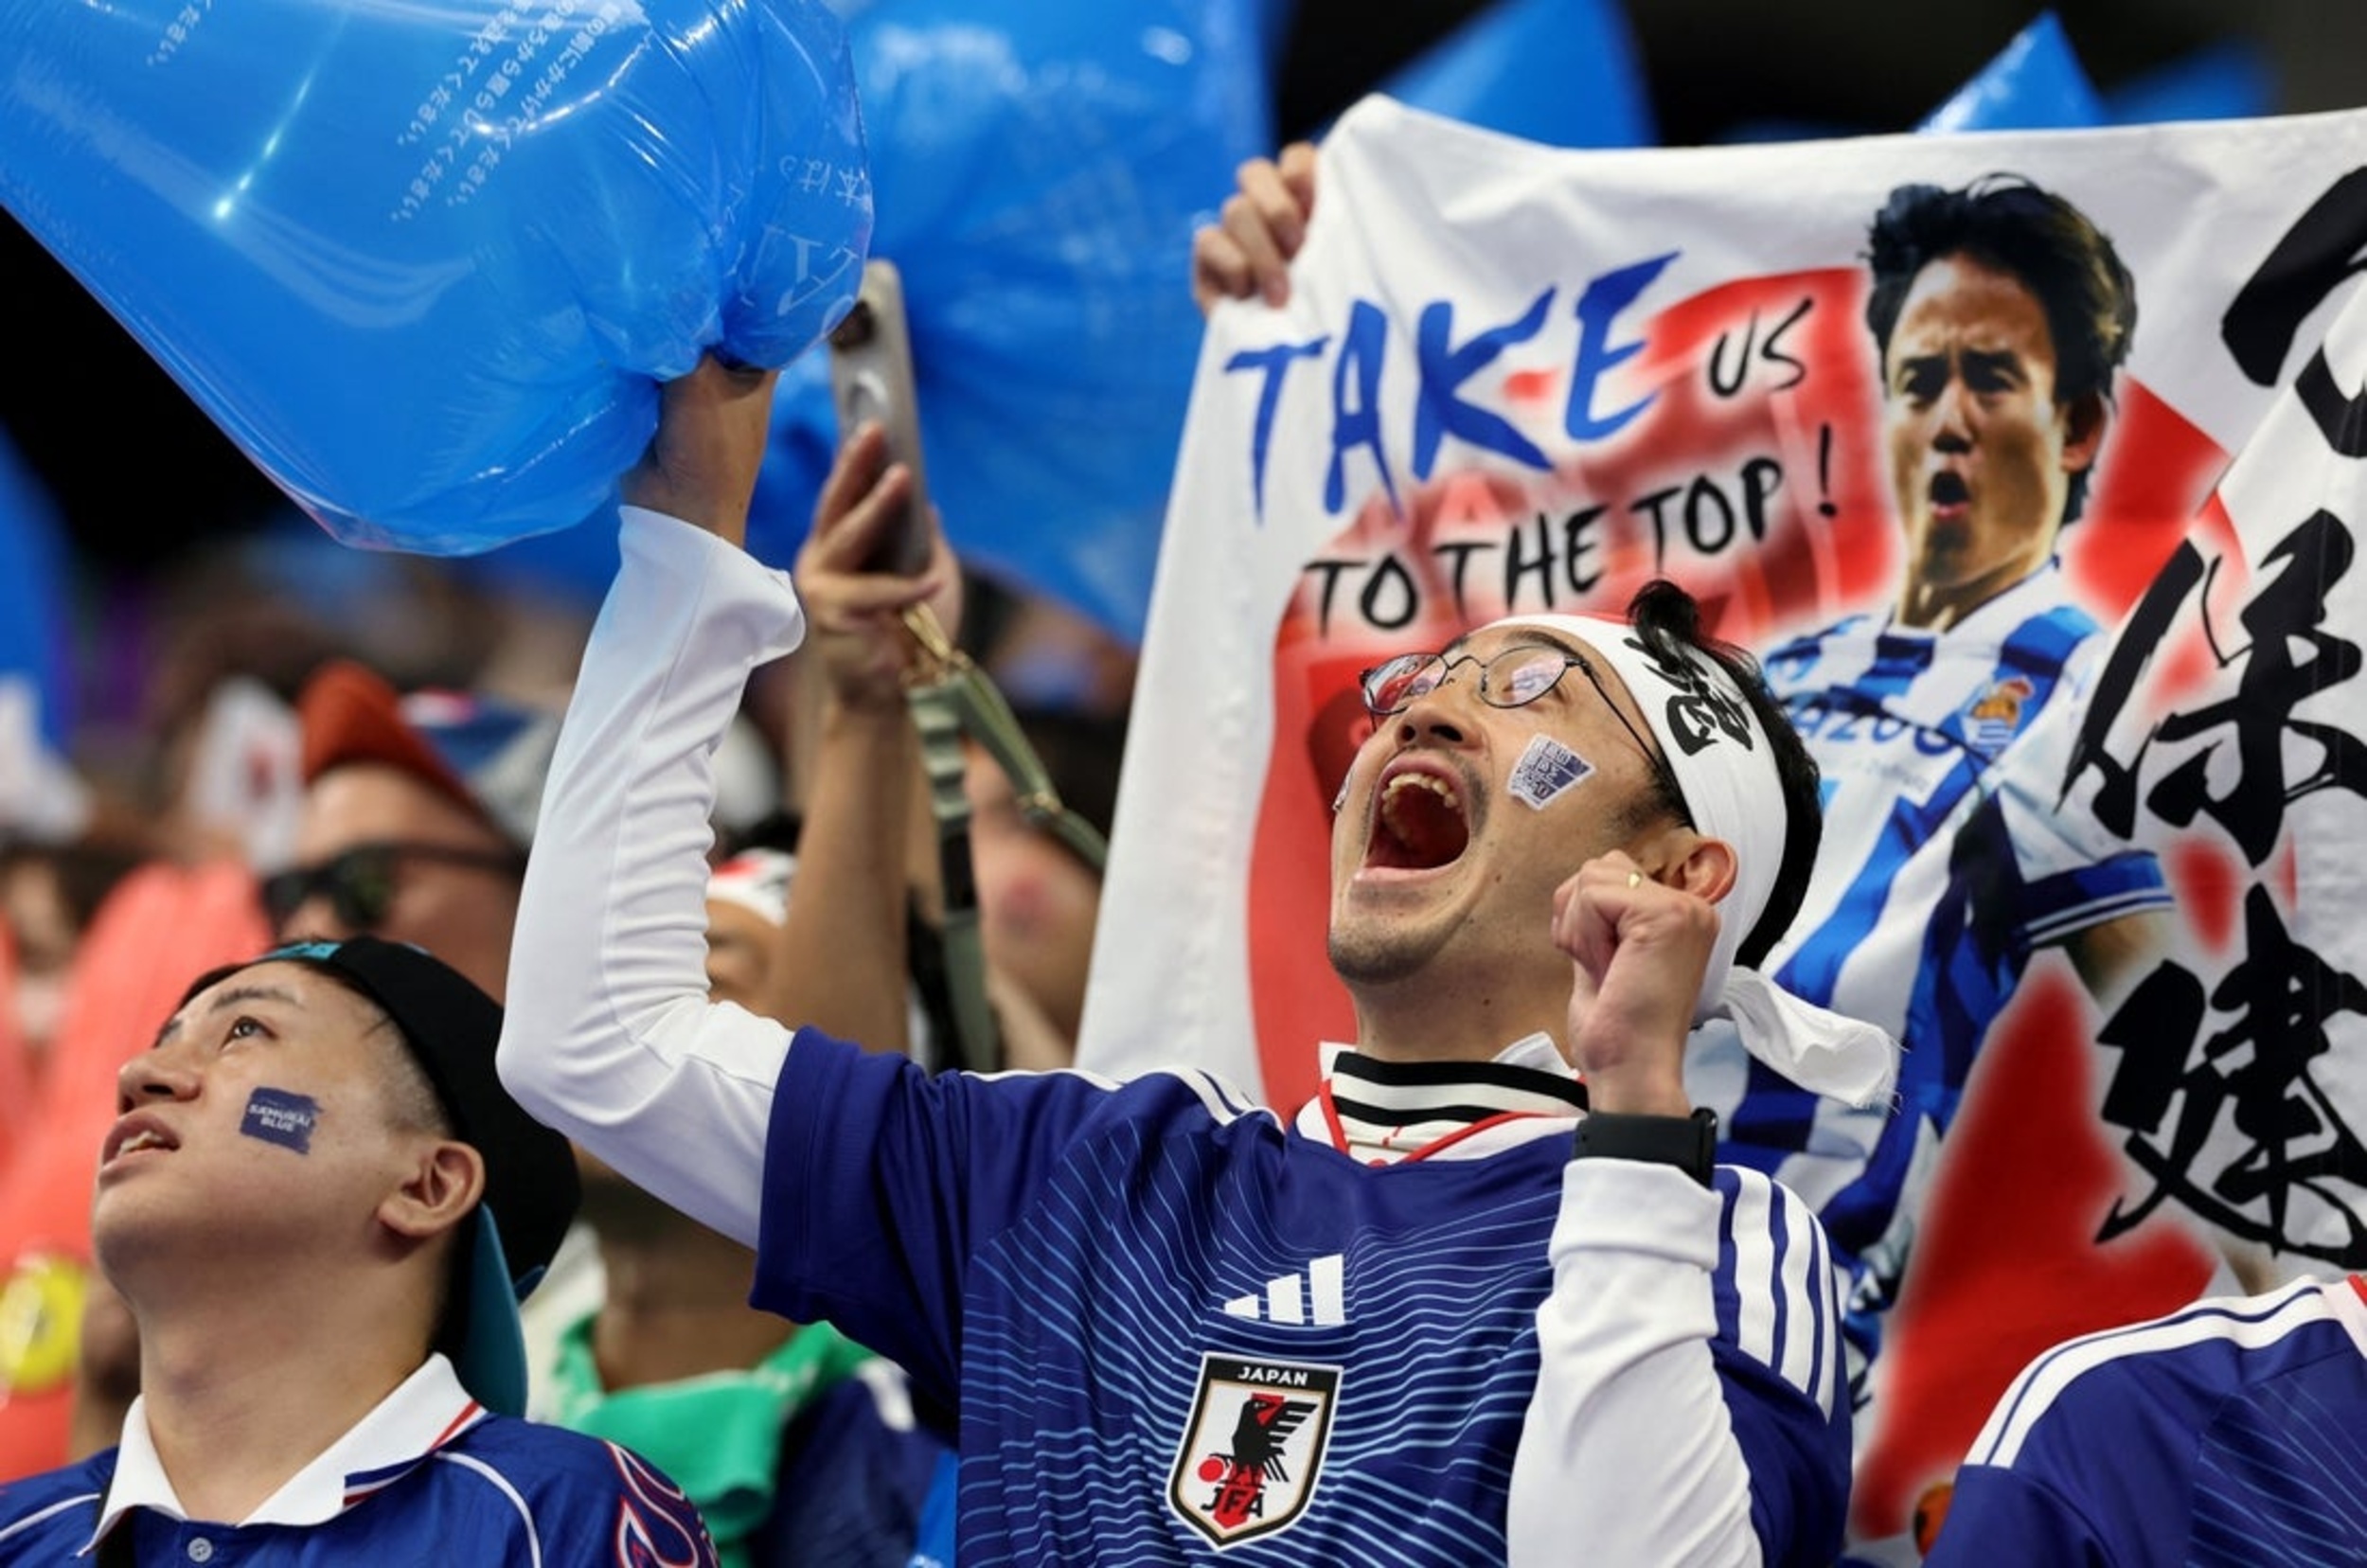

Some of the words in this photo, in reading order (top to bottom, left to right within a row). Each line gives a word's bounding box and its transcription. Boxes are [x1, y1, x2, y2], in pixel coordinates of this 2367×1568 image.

[1224, 249, 1682, 528] TAKE
[1708, 296, 1814, 398] US
[1303, 553, 1418, 640] TO
[1432, 505, 1609, 624] THE
[249, 1103, 311, 1128] SAMURAI
[259, 1116, 294, 1133] BLUE
[1237, 1365, 1308, 1387] JAPAN
[1200, 1486, 1265, 1519] JFA
